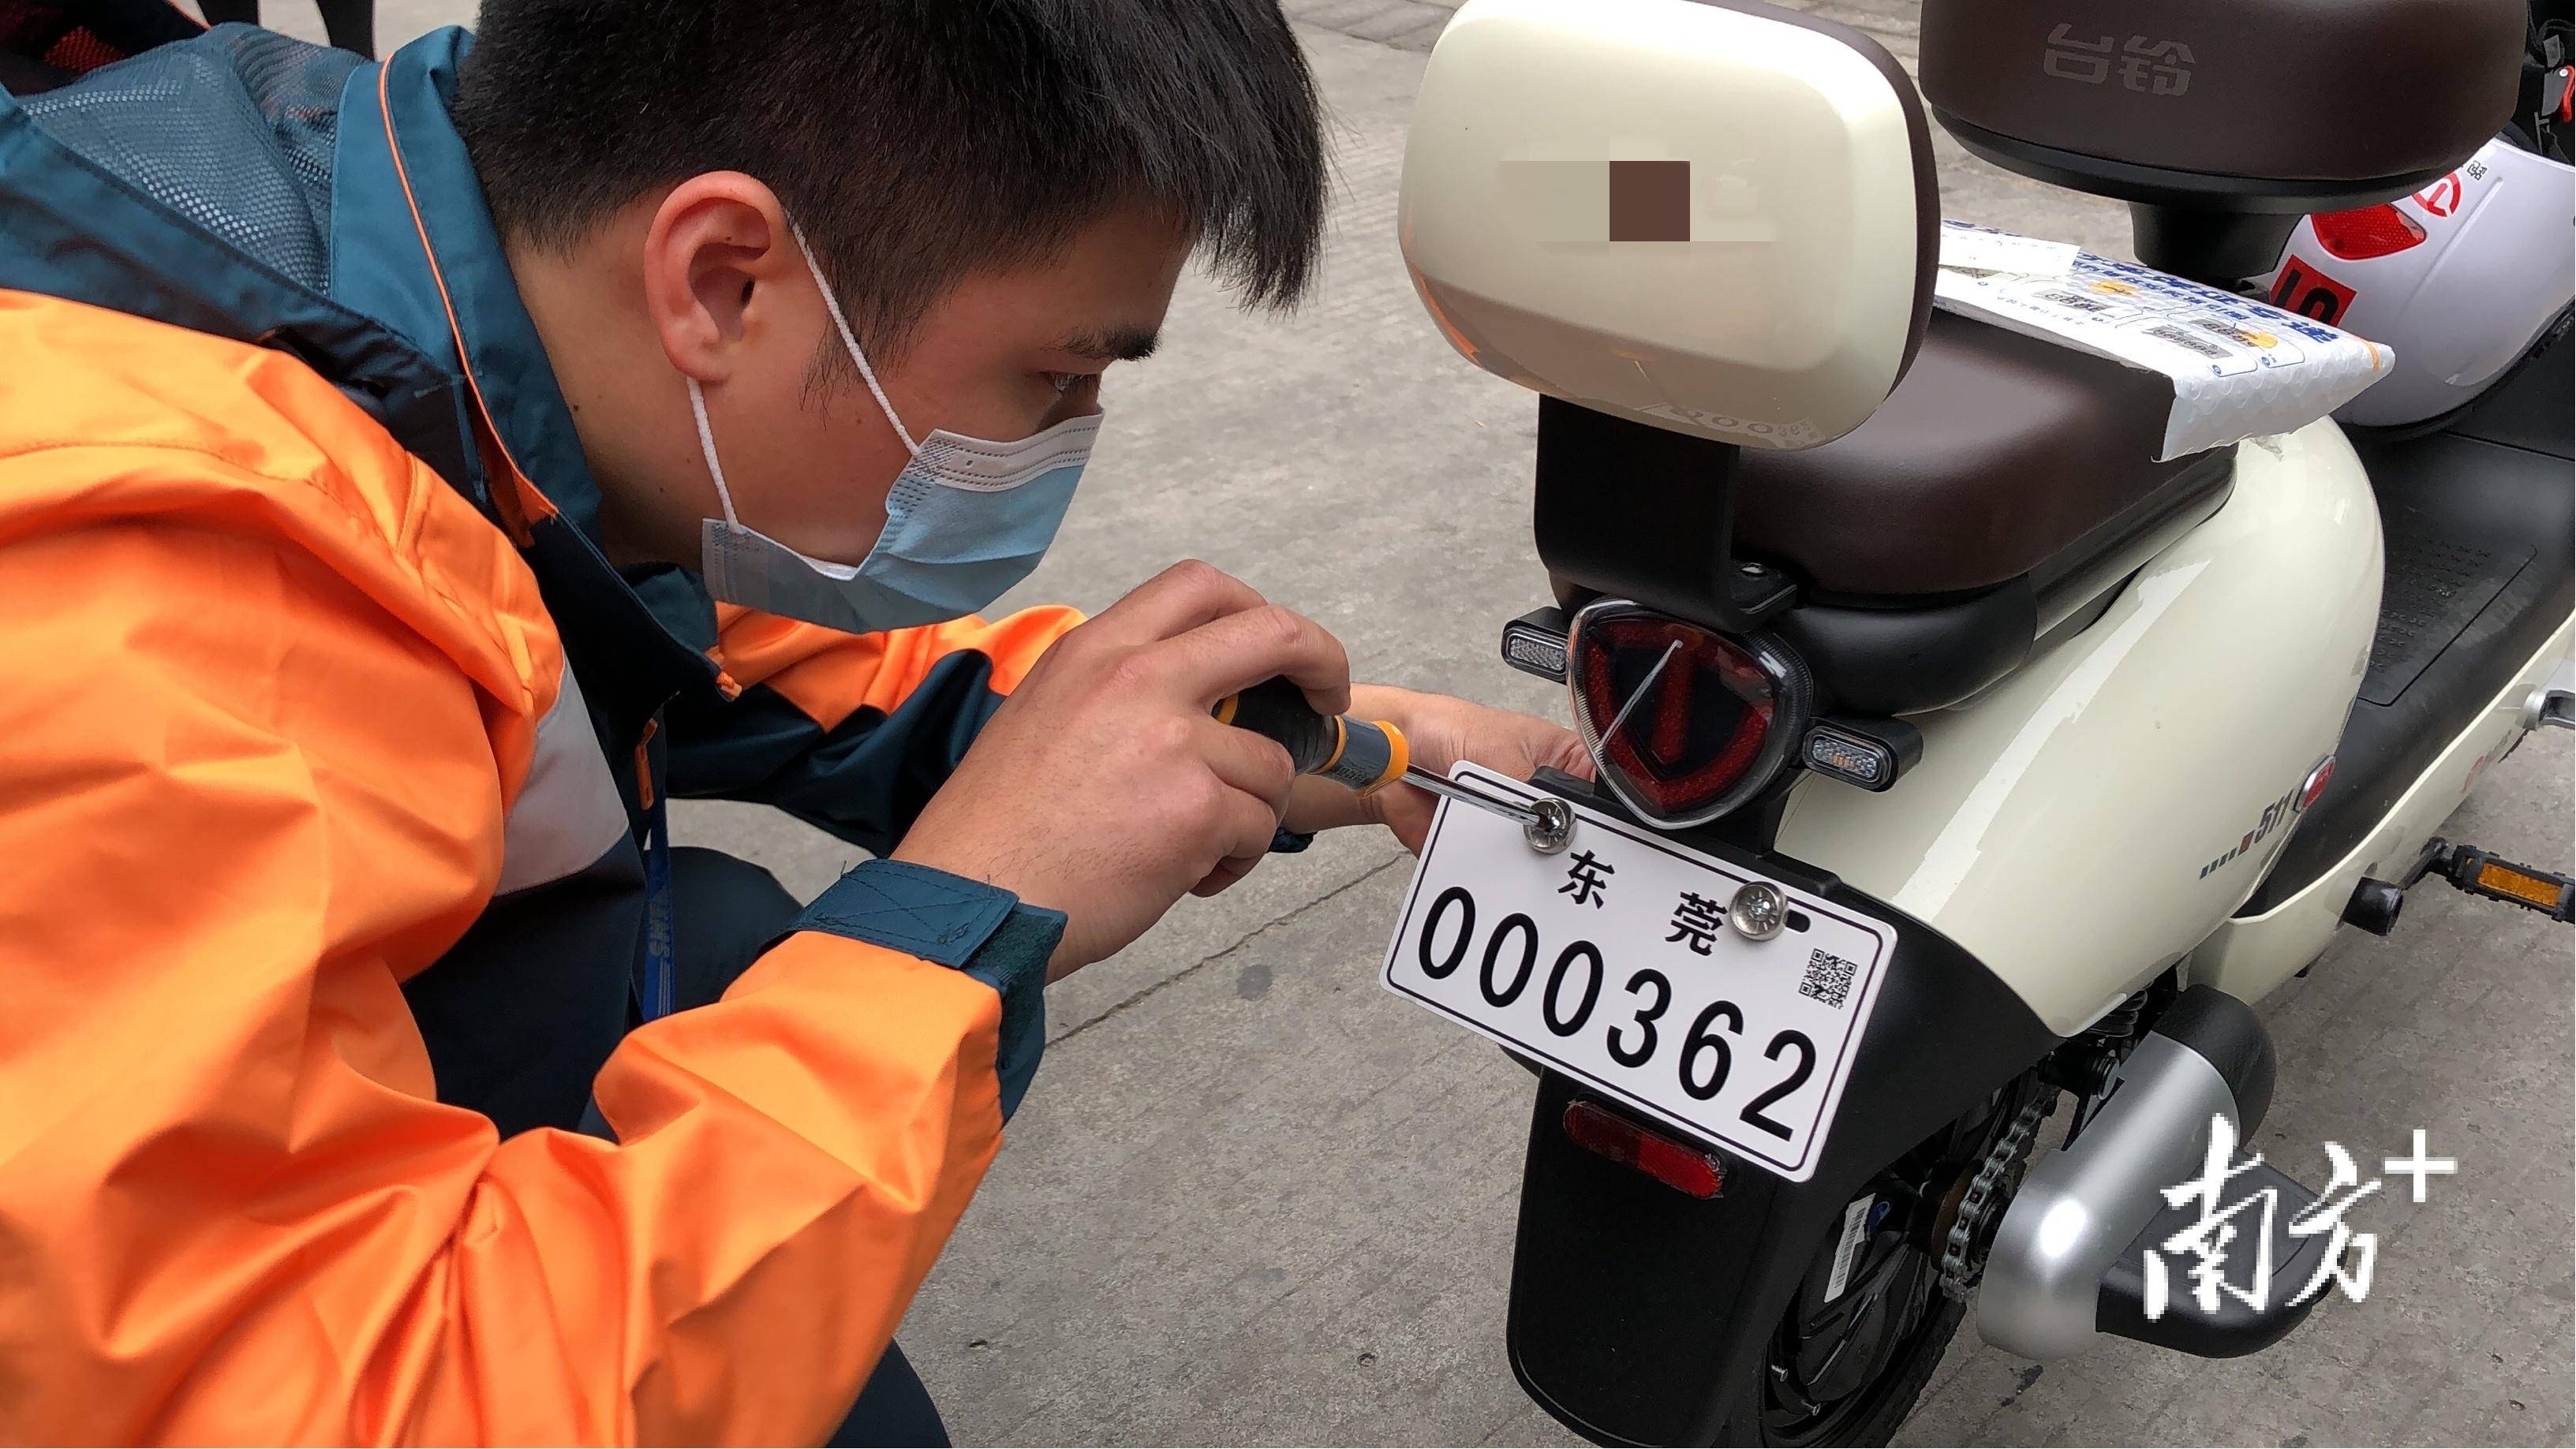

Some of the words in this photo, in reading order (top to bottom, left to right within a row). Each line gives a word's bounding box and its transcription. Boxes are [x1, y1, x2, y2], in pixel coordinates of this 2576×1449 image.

[2044, 23, 2196, 95] 台铃
[2253, 788, 2294, 844] 511
[1557, 850, 1727, 956] 东莞
[1418, 886, 1817, 1142] 000362
